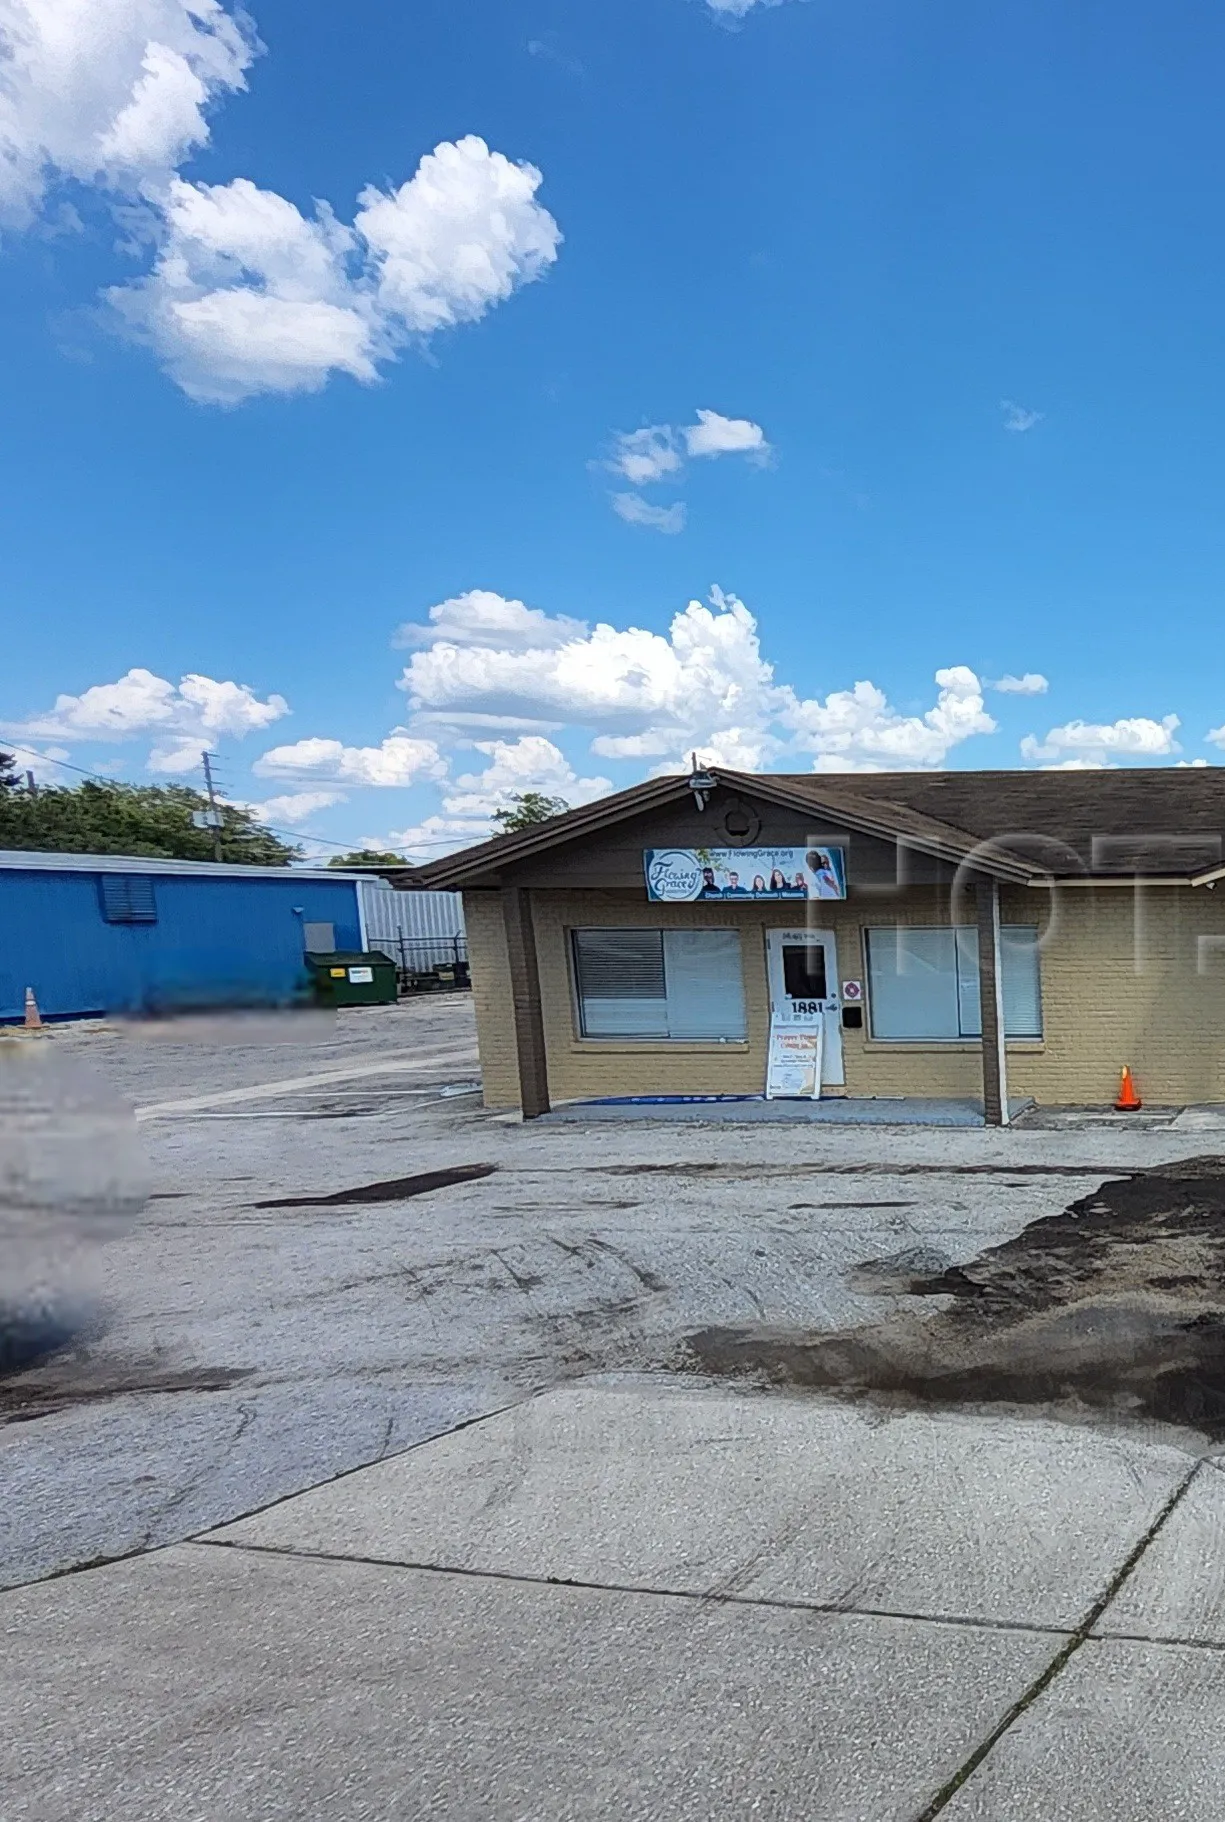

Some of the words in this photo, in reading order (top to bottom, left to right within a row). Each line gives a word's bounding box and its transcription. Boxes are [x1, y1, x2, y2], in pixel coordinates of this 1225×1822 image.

[651, 861, 701, 889] Flowing
[654, 877, 688, 896] Grace
[792, 1001, 823, 1015] 1881
